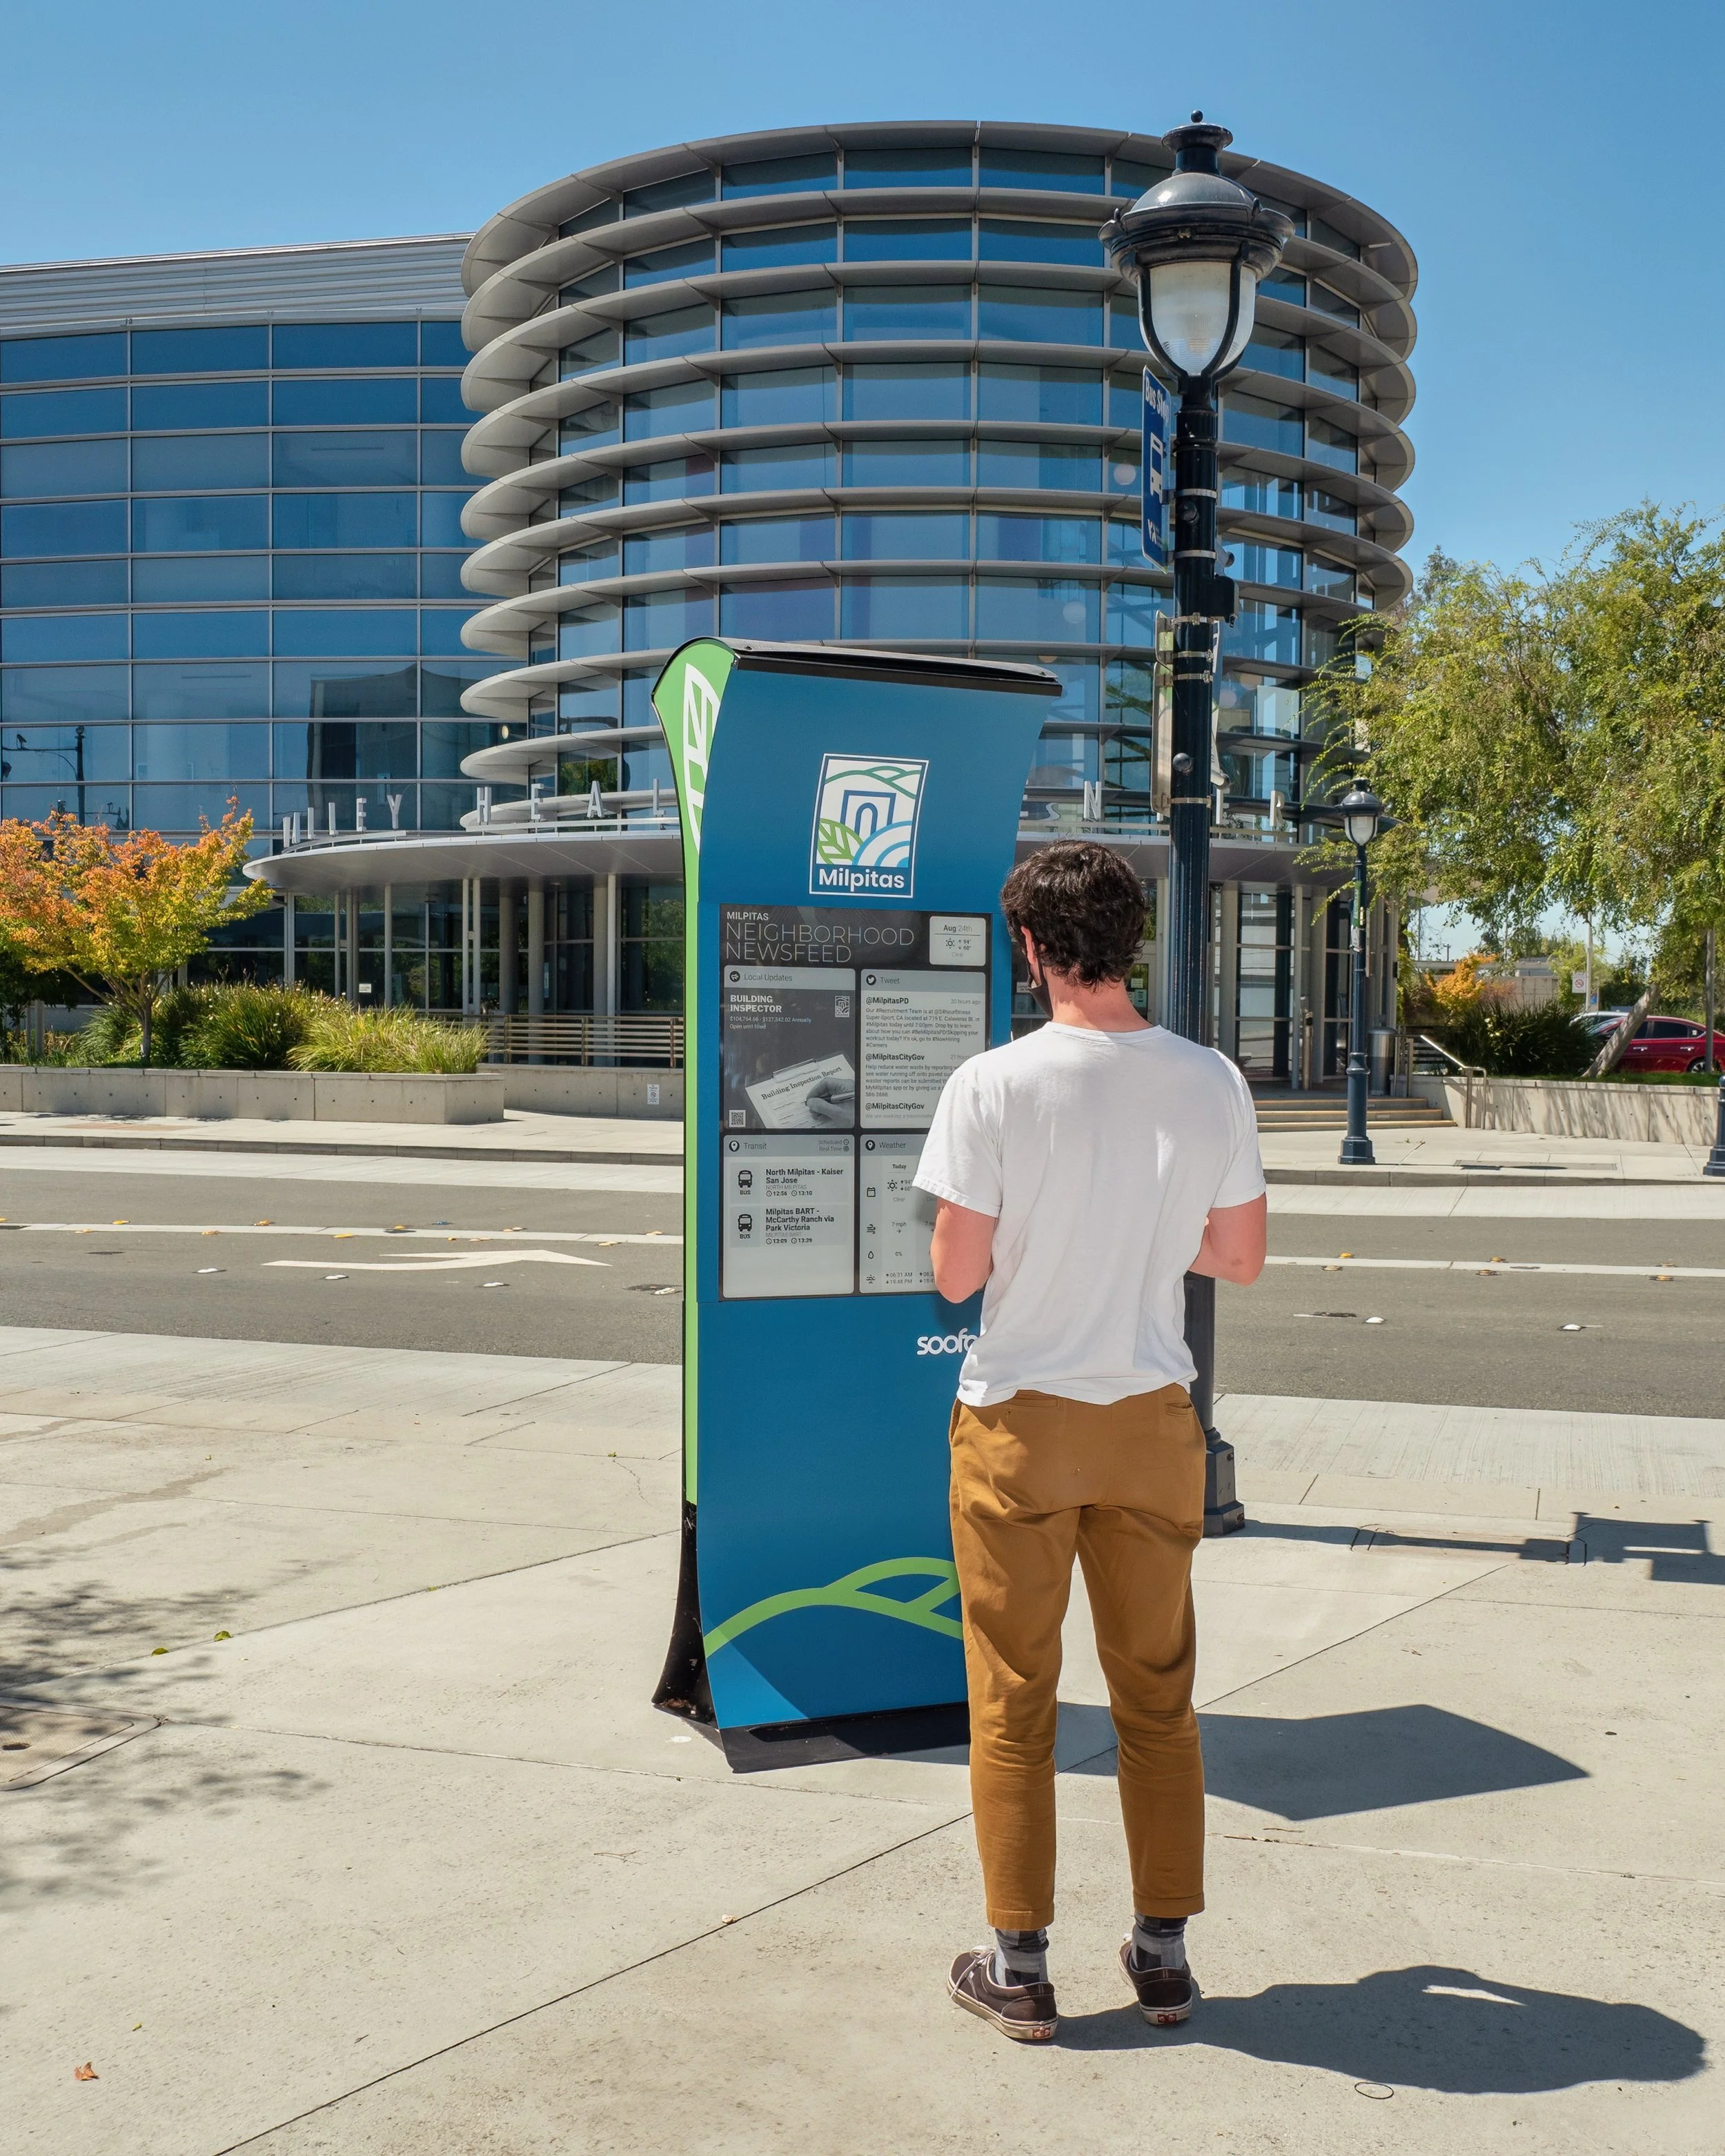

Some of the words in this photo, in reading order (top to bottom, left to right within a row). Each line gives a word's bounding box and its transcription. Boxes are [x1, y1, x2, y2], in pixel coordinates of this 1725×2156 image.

[1145, 375, 1156, 410] Bus
[1156, 388, 1170, 427] Stop
[477, 778, 667, 825] HEAL
[819, 867, 905, 892] Milpitas
[727, 911, 769, 921] MILPITAS
[943, 924, 956, 933] Aug
[726, 922, 914, 945] NEIGHBORHOOD
[726, 942, 851, 962] NEWSFEED
[765, 974, 793, 982] Updates
[730, 994, 773, 1003] BUILDING
[730, 1004, 782, 1013] INSPECTOR
[865, 1054, 925, 1062] @MilpitasCityGov
[761, 1086, 790, 1100] Building
[789, 1073, 822, 1089] Inspection
[821, 1067, 842, 1078] Report
[865, 1102, 925, 1111] @MilpitasCityGov
[787, 1168, 815, 1177] Milpitas
[766, 1208, 793, 1216] Milpitas
